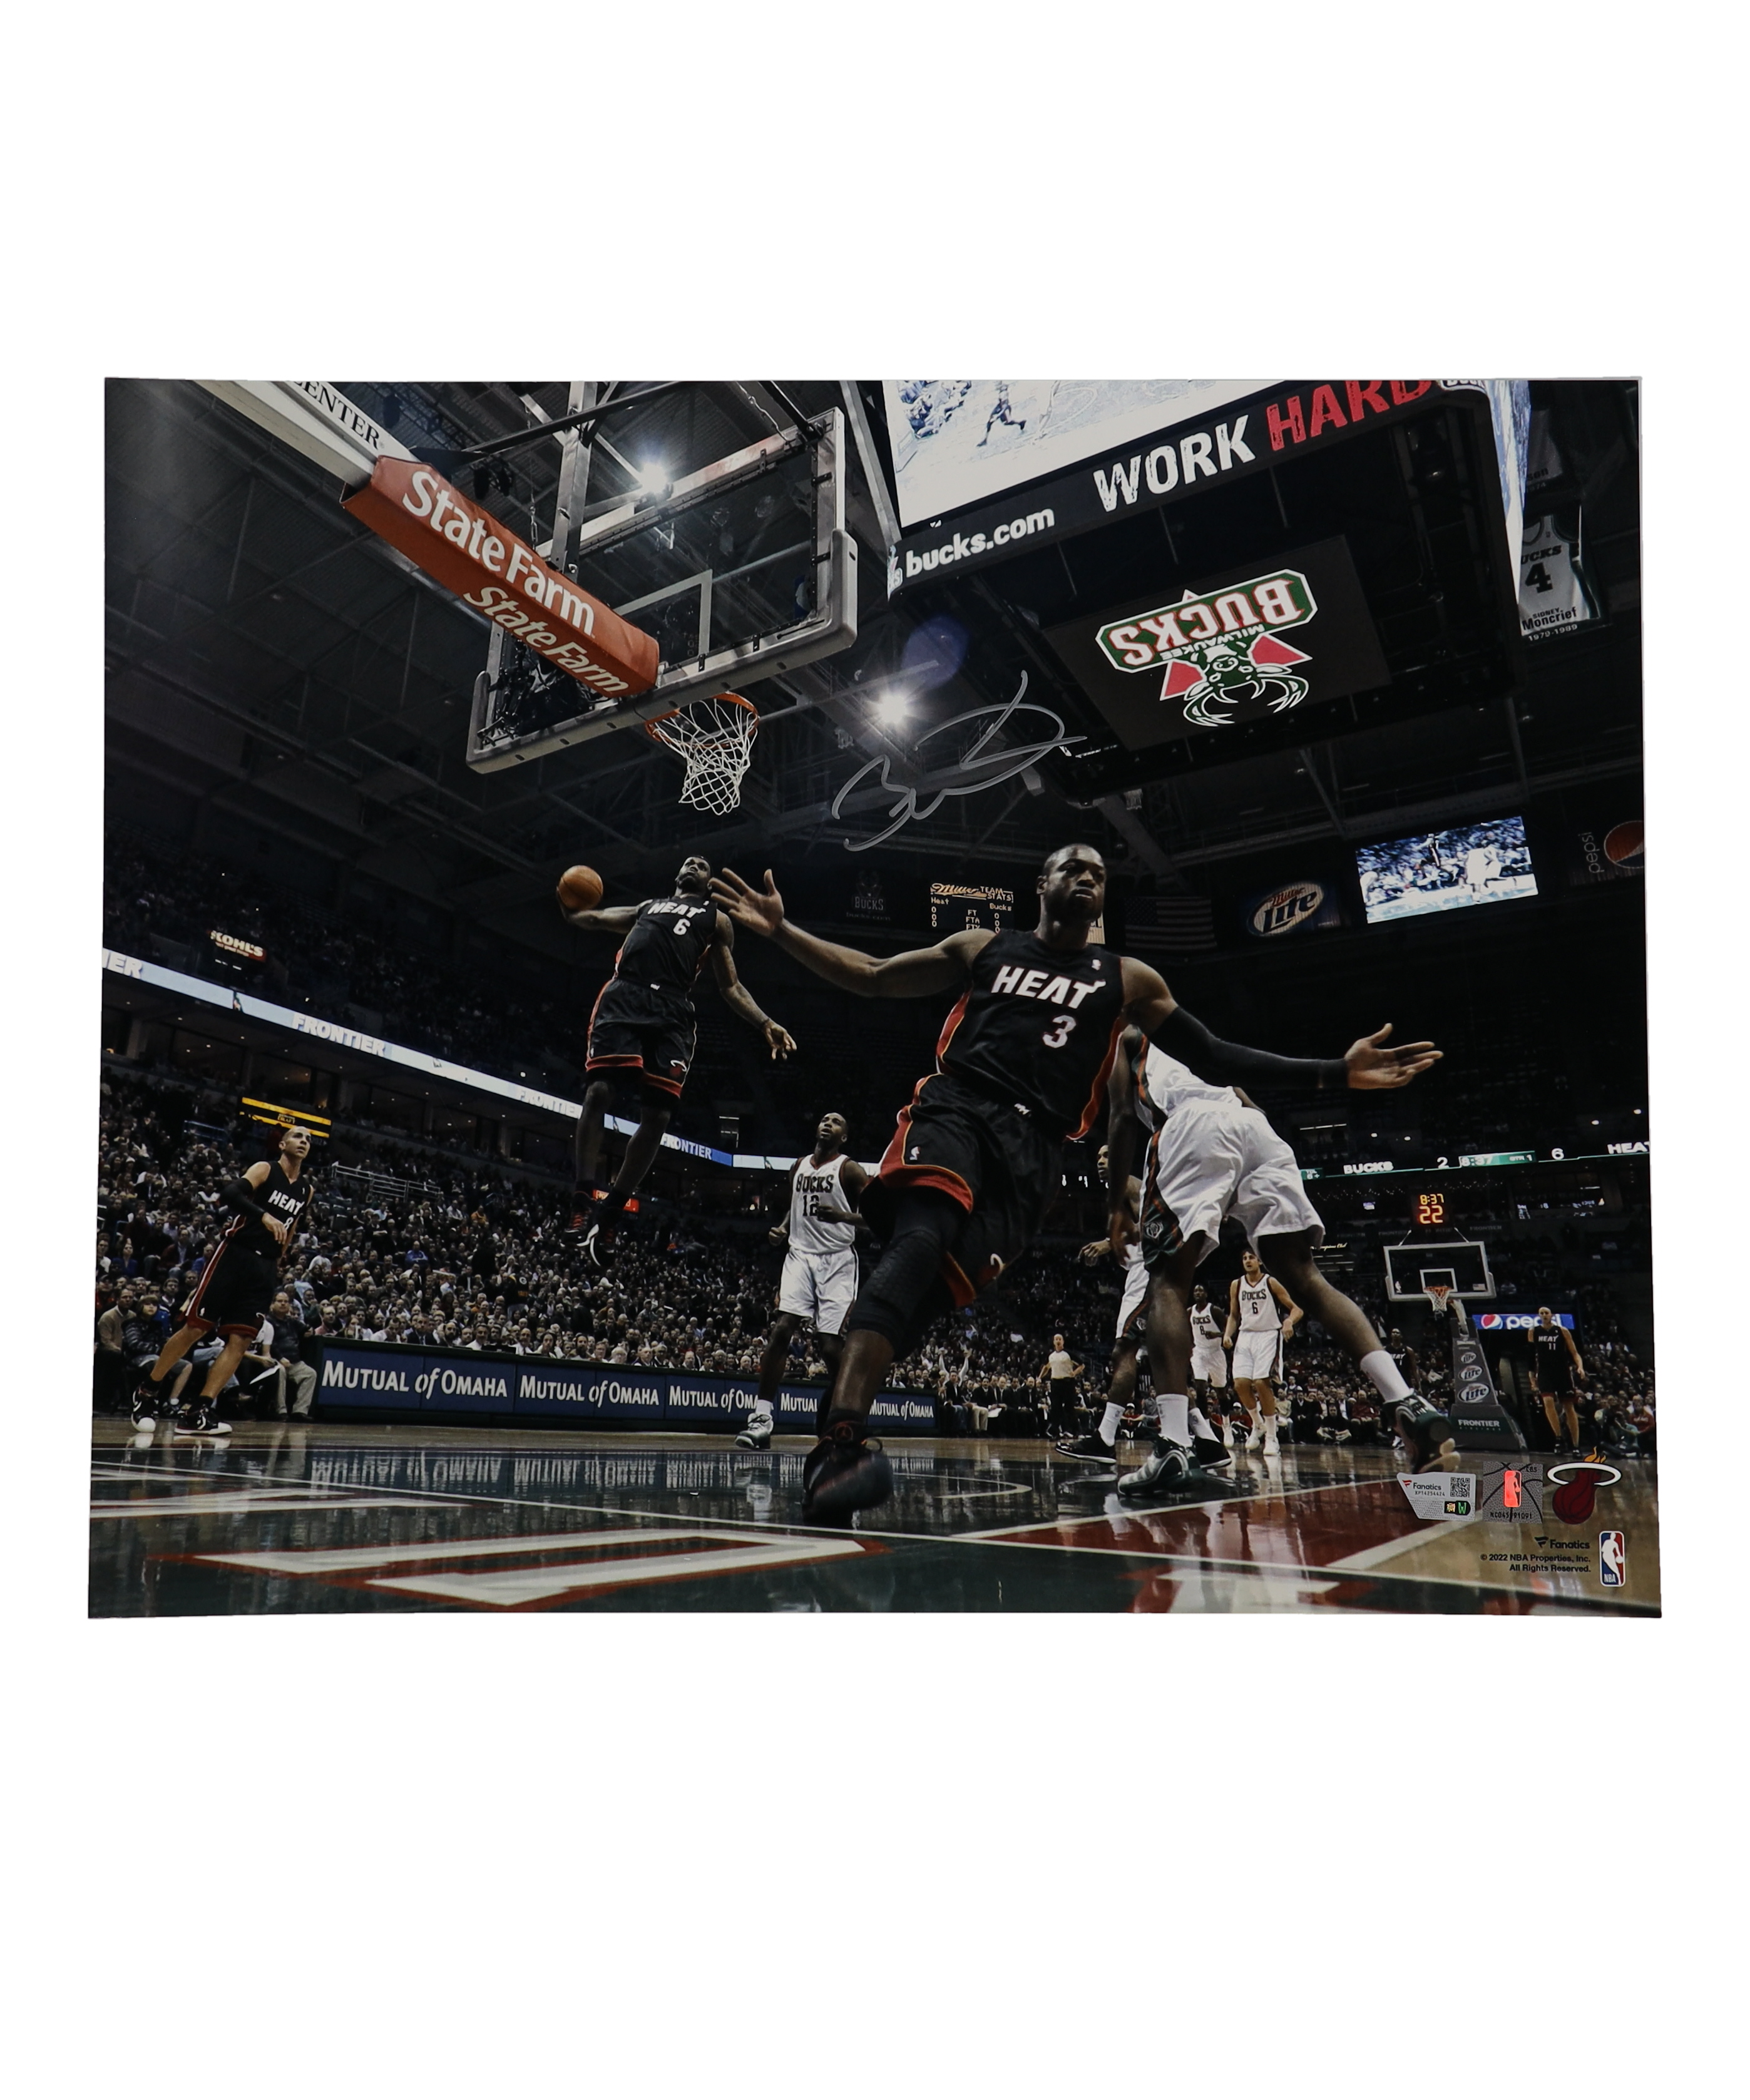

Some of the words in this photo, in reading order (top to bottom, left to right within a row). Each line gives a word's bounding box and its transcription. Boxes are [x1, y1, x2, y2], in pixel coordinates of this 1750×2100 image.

[294, 381, 379, 450] ENTER
[906, 508, 1055, 578] bucks.com
[1093, 414, 1256, 512] WORK
[402, 471, 506, 572] State
[506, 543, 595, 637] Farm
[1522, 545, 1562, 565] UCKS
[1525, 563, 1553, 593] 4
[1107, 578, 1305, 667] BUCKS
[1522, 607, 1578, 630] Moncrief
[1532, 607, 1560, 620] SIDNEY
[463, 586, 557, 648] State
[542, 642, 629, 692] Farm
[1160, 624, 1266, 661] MILWAUKEE
[1578, 832, 1605, 873] pepsi
[980, 886, 1004, 896] TEAM
[987, 893, 1011, 901] STATS
[647, 901, 707, 919] HEAT
[854, 896, 884, 911] BUCKS
[990, 903, 1012, 911] Bucks
[673, 918, 691, 936] 6
[215, 931, 264, 957] KOHL'S
[991, 965, 1107, 1010] HEAT
[290, 1012, 386, 1056] FRONTIER
[1042, 1015, 1077, 1048] 3
[1343, 1160, 1394, 1175] BUCKS
[1436, 1157, 1449, 1169] 2
[1551, 1147, 1565, 1160] 6
[796, 1173, 834, 1193] BUCKS
[267, 1189, 305, 1216] HEAT
[802, 1195, 819, 1217] 12
[1419, 1193, 1445, 1206] 8:37
[1418, 1205, 1444, 1225] 22
[1242, 1289, 1266, 1301] BUCKS
[1252, 1302, 1259, 1314] 6
[1548, 1343, 1556, 1351] 11
[321, 1360, 409, 1392] MUTUAL
[414, 1368, 441, 1400] of
[441, 1370, 508, 1398] OMAHA
[519, 1375, 585, 1401] MUTUAL
[588, 1380, 608, 1408] of
[608, 1381, 659, 1406] OMAHA
[669, 1385, 719, 1408] MUTUAL
[721, 1388, 735, 1413] of
[735, 1390, 759, 1409] OMA
[869, 1399, 900, 1416] MUTUAL
[901, 1401, 909, 1421] of
[909, 1401, 934, 1418] OMAHA
[1458, 1419, 1500, 1427] FRONTIER
[1413, 1482, 1441, 1490] Fanatics
[1550, 1539, 1590, 1549] Fanatics
[1509, 1564, 1520, 1572] All
[1522, 1564, 1548, 1573] Rights
[1550, 1564, 1591, 1572] Reserved.
[1530, 1554, 1574, 1564] Properties,
[1604, 1574, 1616, 1583] NBA
